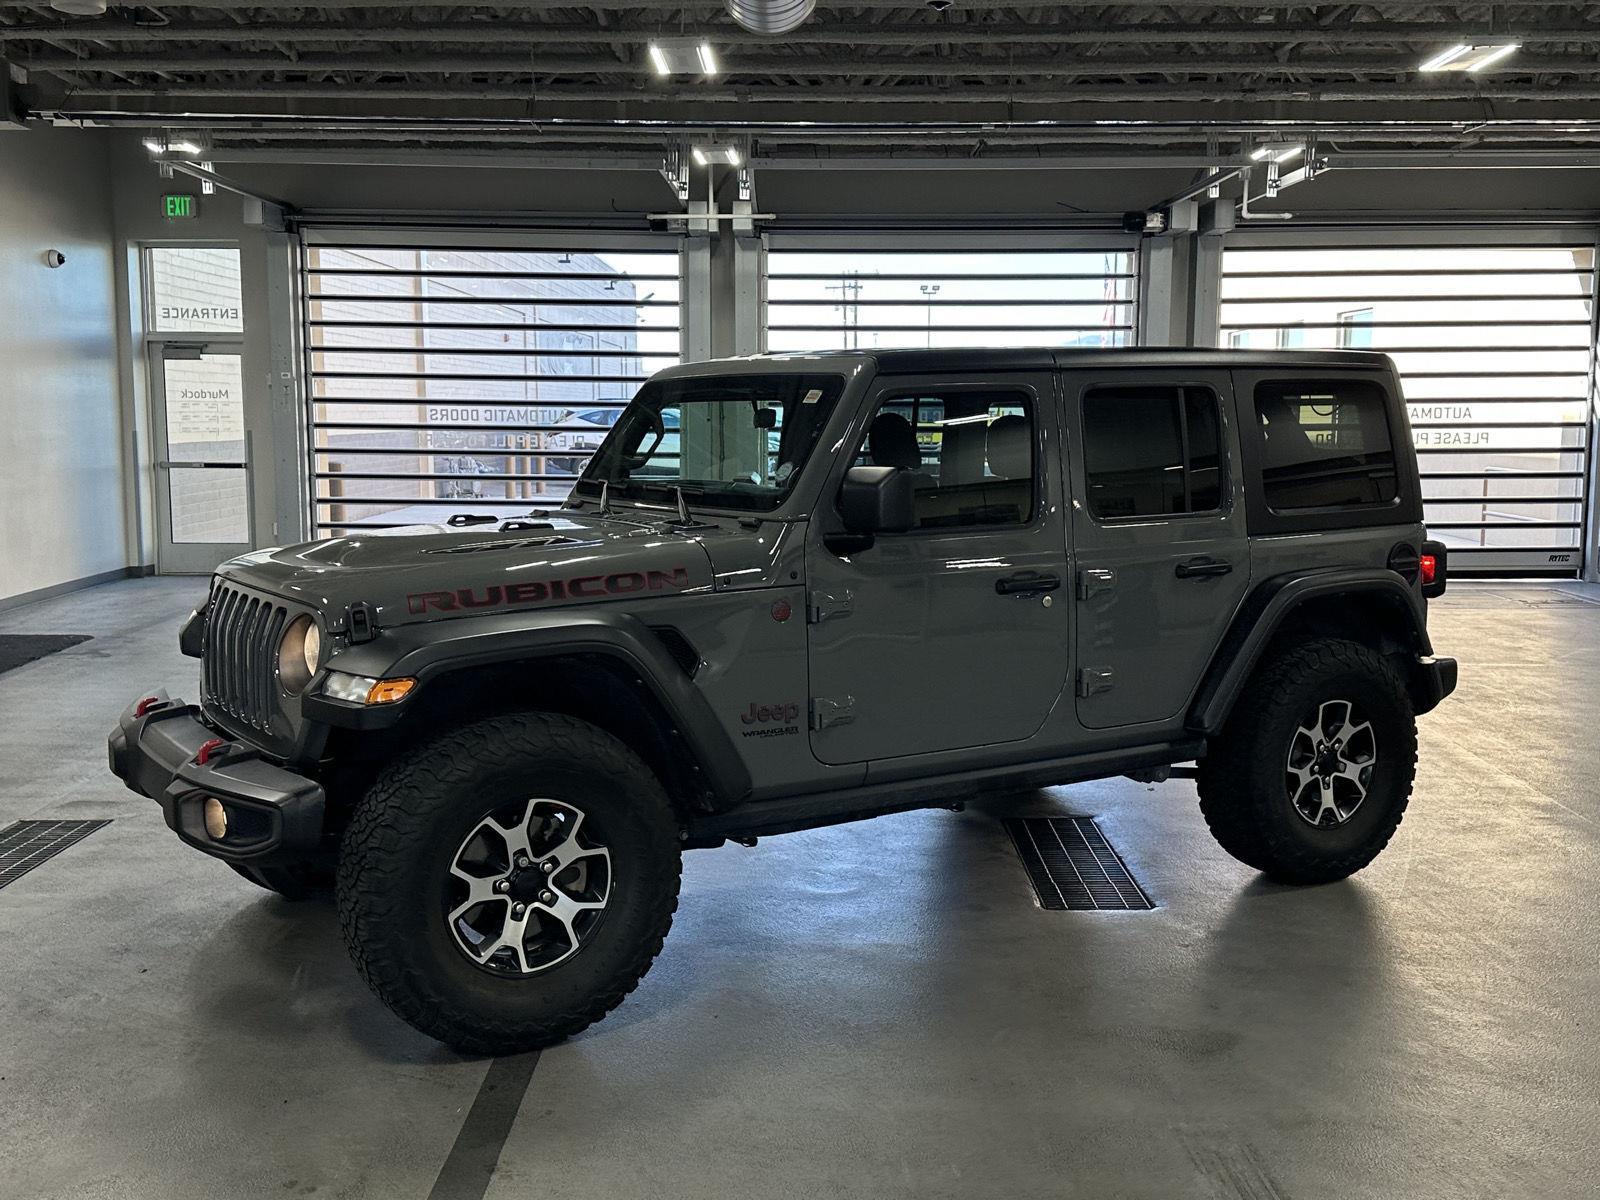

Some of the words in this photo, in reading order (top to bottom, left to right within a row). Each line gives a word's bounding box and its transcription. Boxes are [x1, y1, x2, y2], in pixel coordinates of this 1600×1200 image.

[166, 196, 191, 217] EXIT
[1549, 554, 1571, 562] RYTEC
[406, 567, 689, 615] RUBICON
[741, 702, 800, 724] Jeep
[742, 726, 800, 738] WRANGLER
